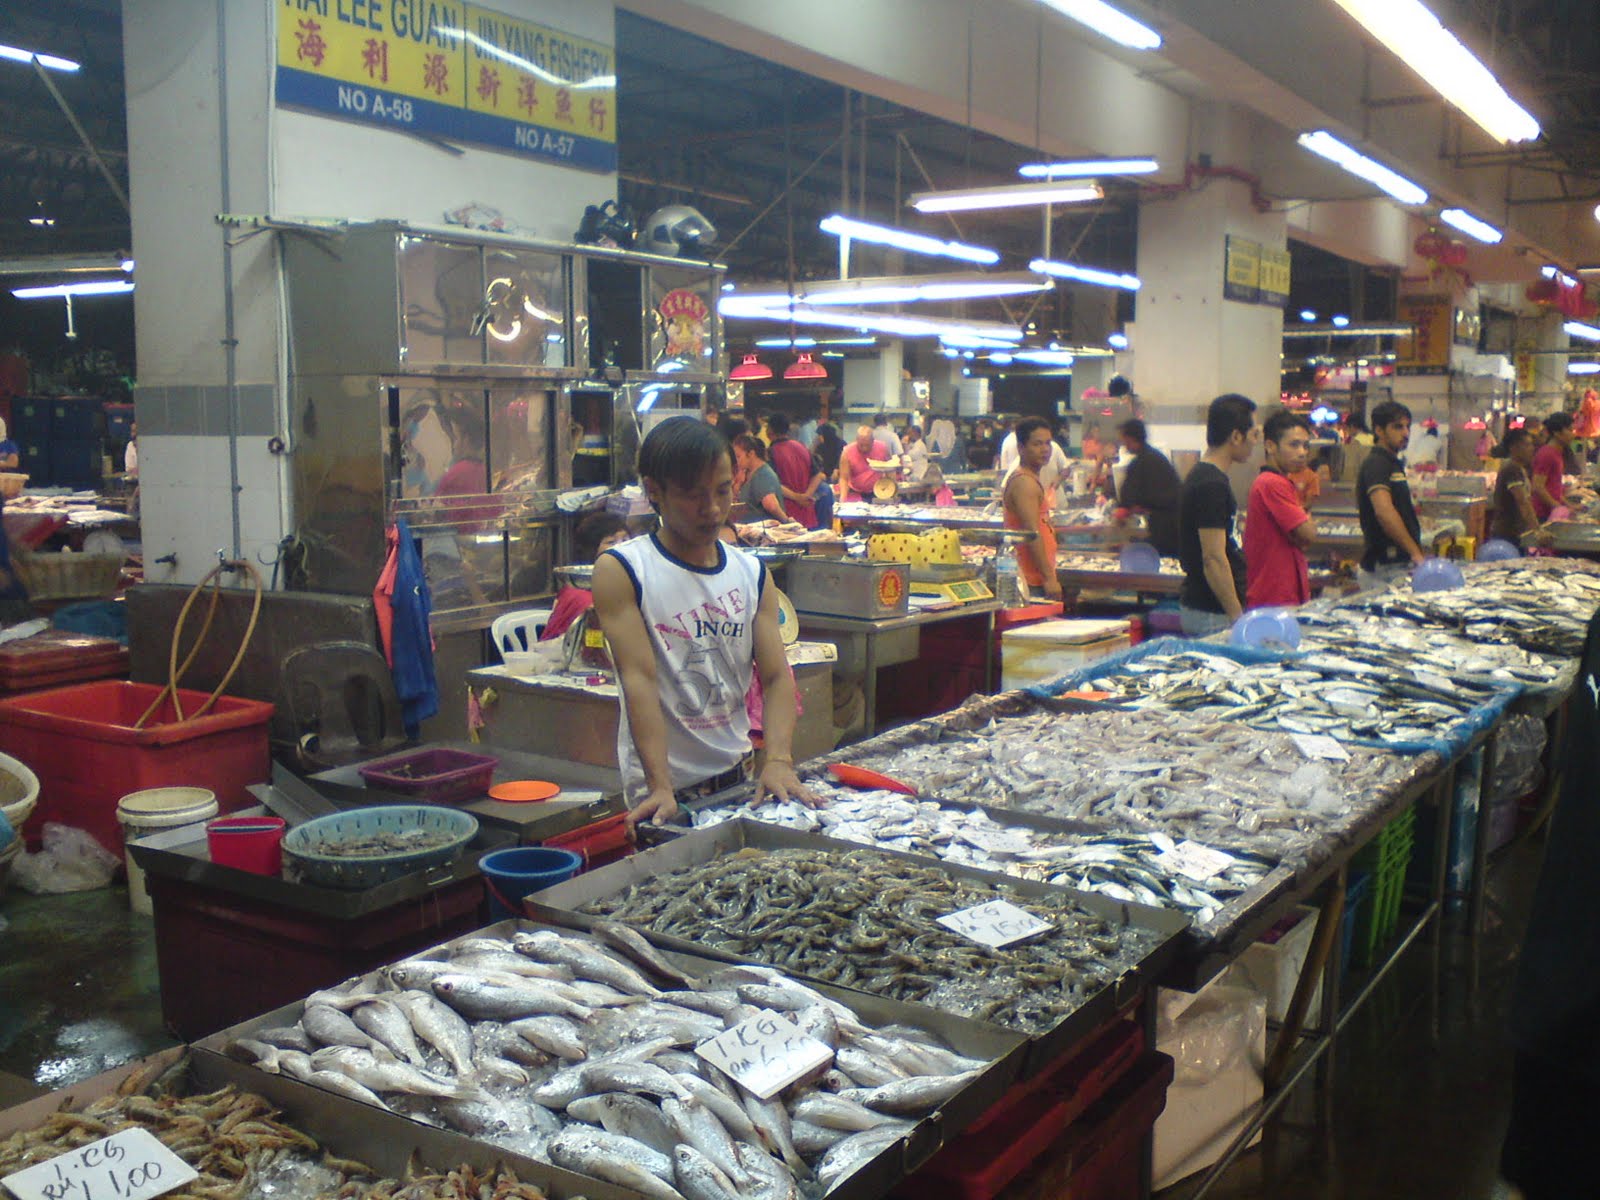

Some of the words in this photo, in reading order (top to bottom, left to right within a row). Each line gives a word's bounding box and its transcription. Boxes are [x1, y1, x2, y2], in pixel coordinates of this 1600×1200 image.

[391, 0, 456, 51] GUAN
[475, 16, 499, 60] JIN
[502, 23, 545, 73] YANG
[294, 18, 448, 96] 海利源
[338, 86, 367, 111] NO
[371, 93, 414, 122] A-58
[515, 126, 539, 149] NO
[541, 133, 575, 157] A-57
[655, 587, 745, 651] NINE
[694, 620, 744, 639] INCH
